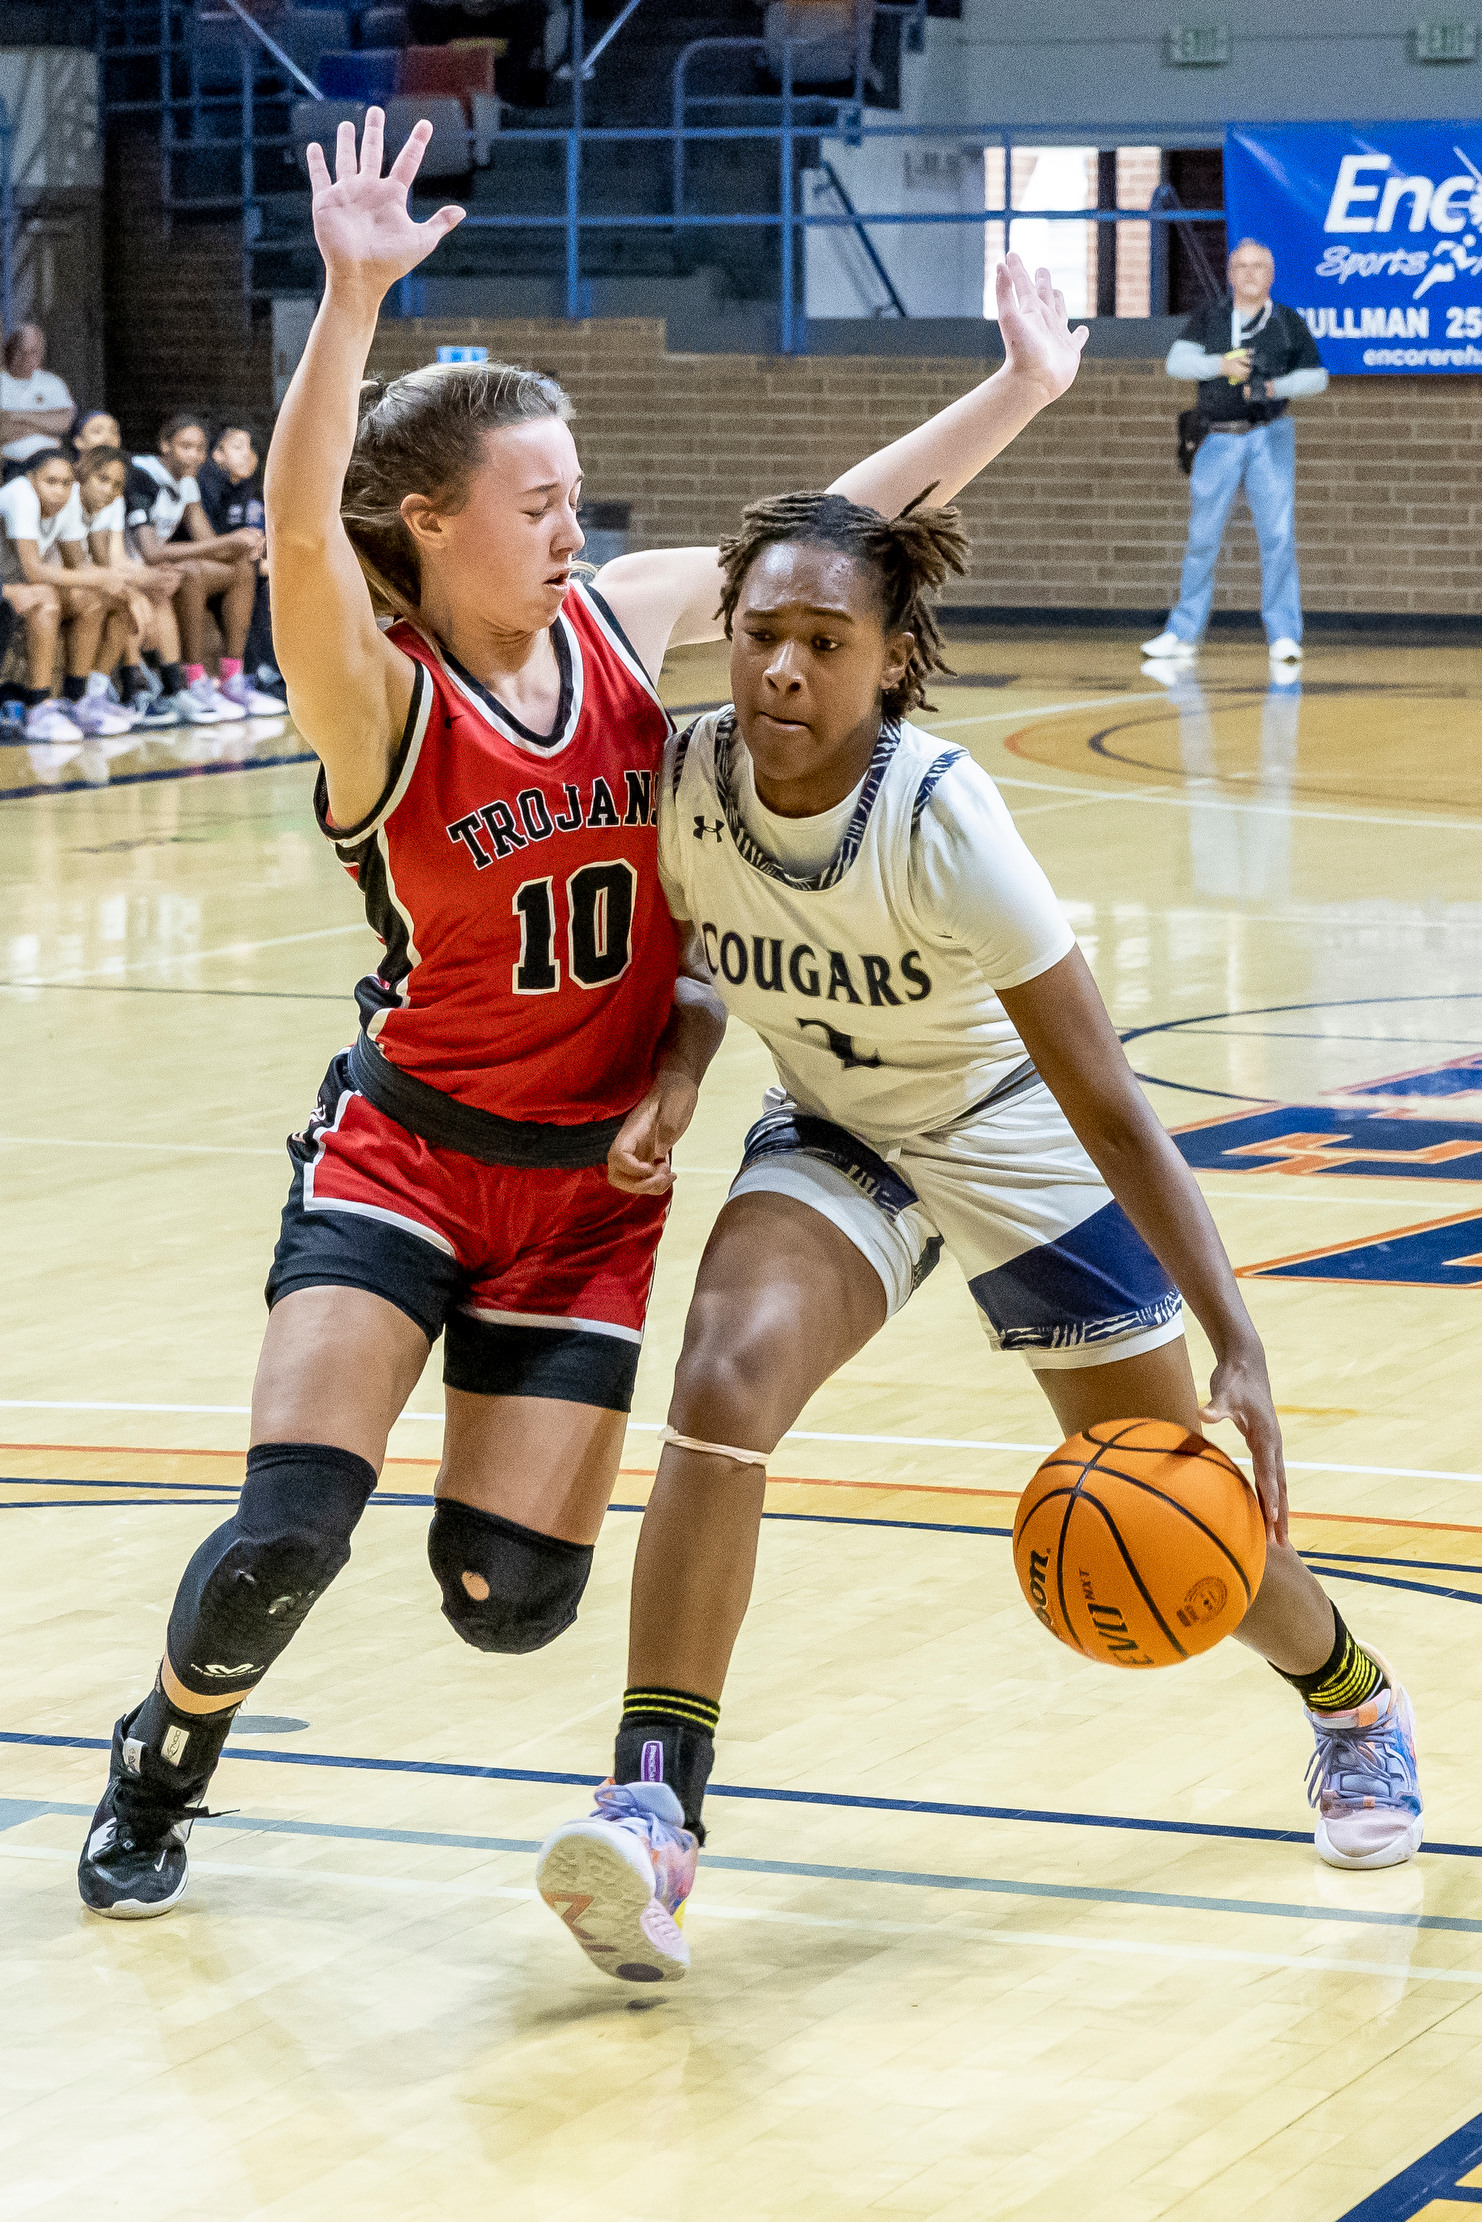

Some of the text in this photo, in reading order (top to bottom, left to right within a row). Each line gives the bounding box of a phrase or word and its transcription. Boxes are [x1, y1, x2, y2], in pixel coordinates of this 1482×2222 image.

[1324, 153, 1482, 233] Enc
[1315, 245, 1430, 284] Sports
[1297, 306, 1430, 339] ULLMAN
[511, 857, 638, 996] 10
[701, 922, 933, 1007] COUGARS
[1078, 1567, 1095, 1601] NXT
